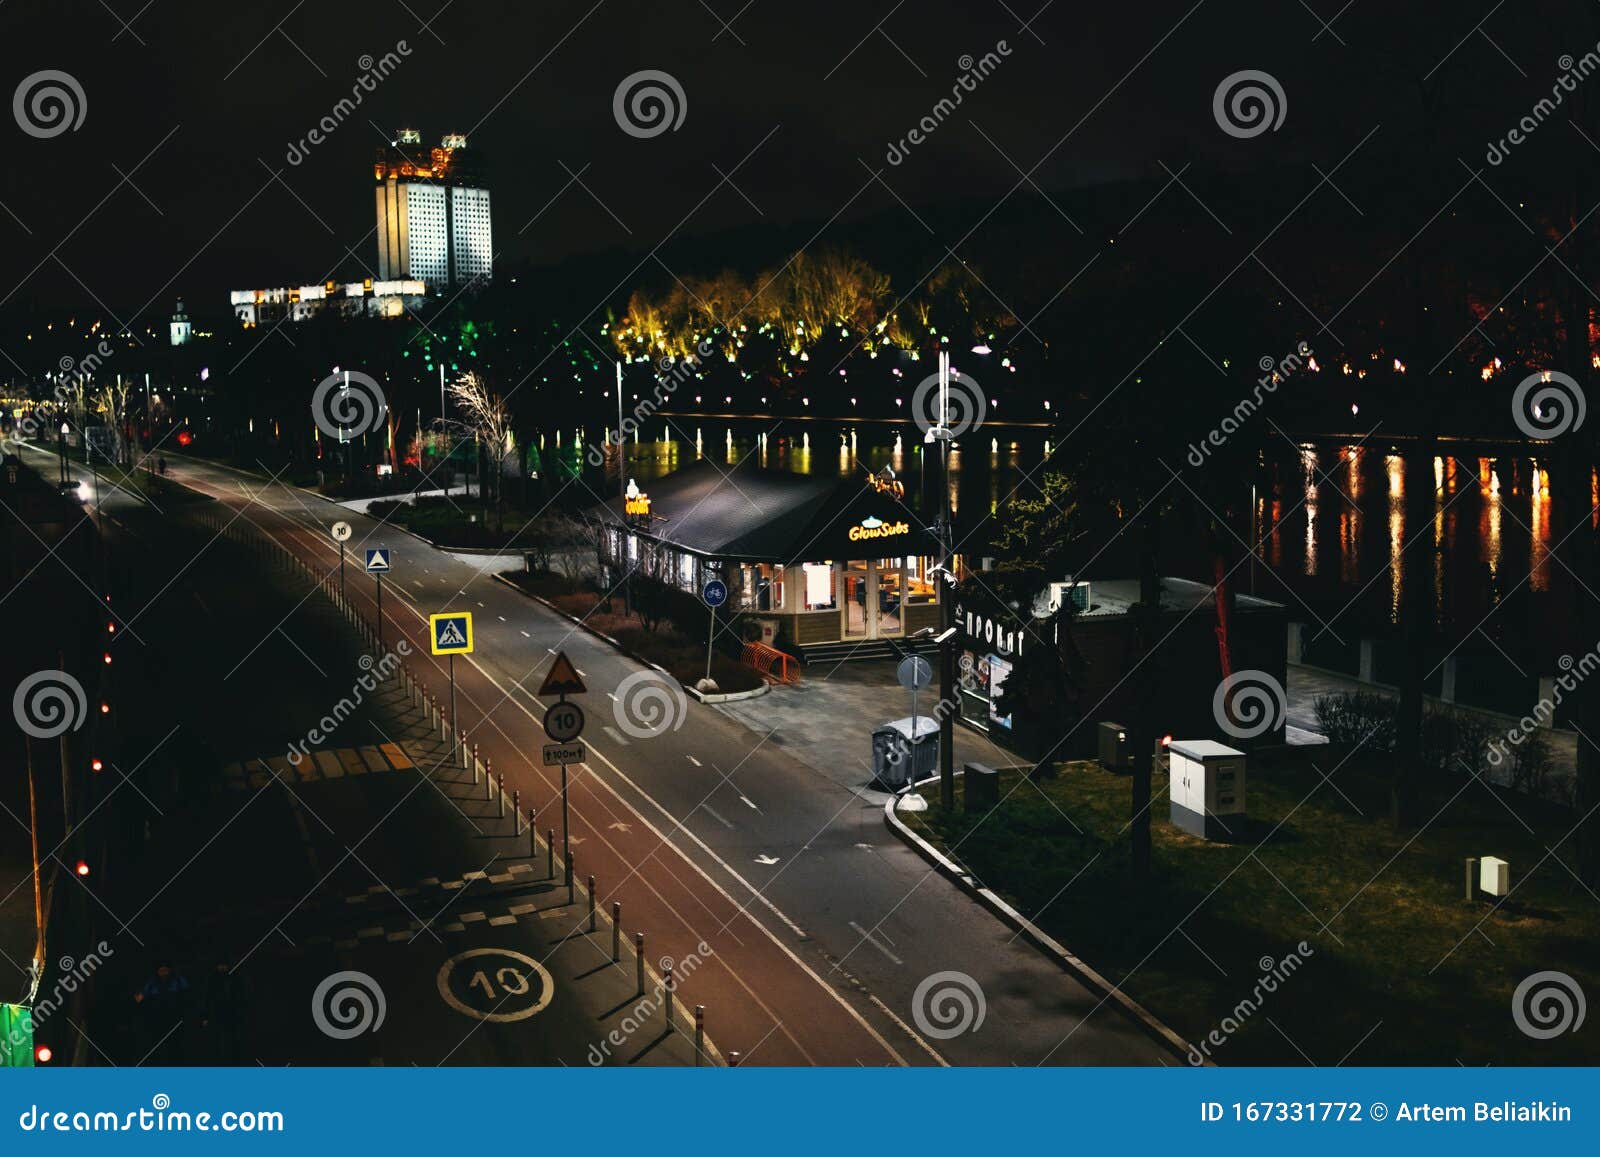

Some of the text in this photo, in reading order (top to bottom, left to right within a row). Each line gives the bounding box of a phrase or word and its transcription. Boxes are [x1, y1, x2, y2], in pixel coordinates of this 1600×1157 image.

[337, 527, 346, 536] 10
[555, 713, 575, 730] 10
[470, 968, 529, 999] 10
